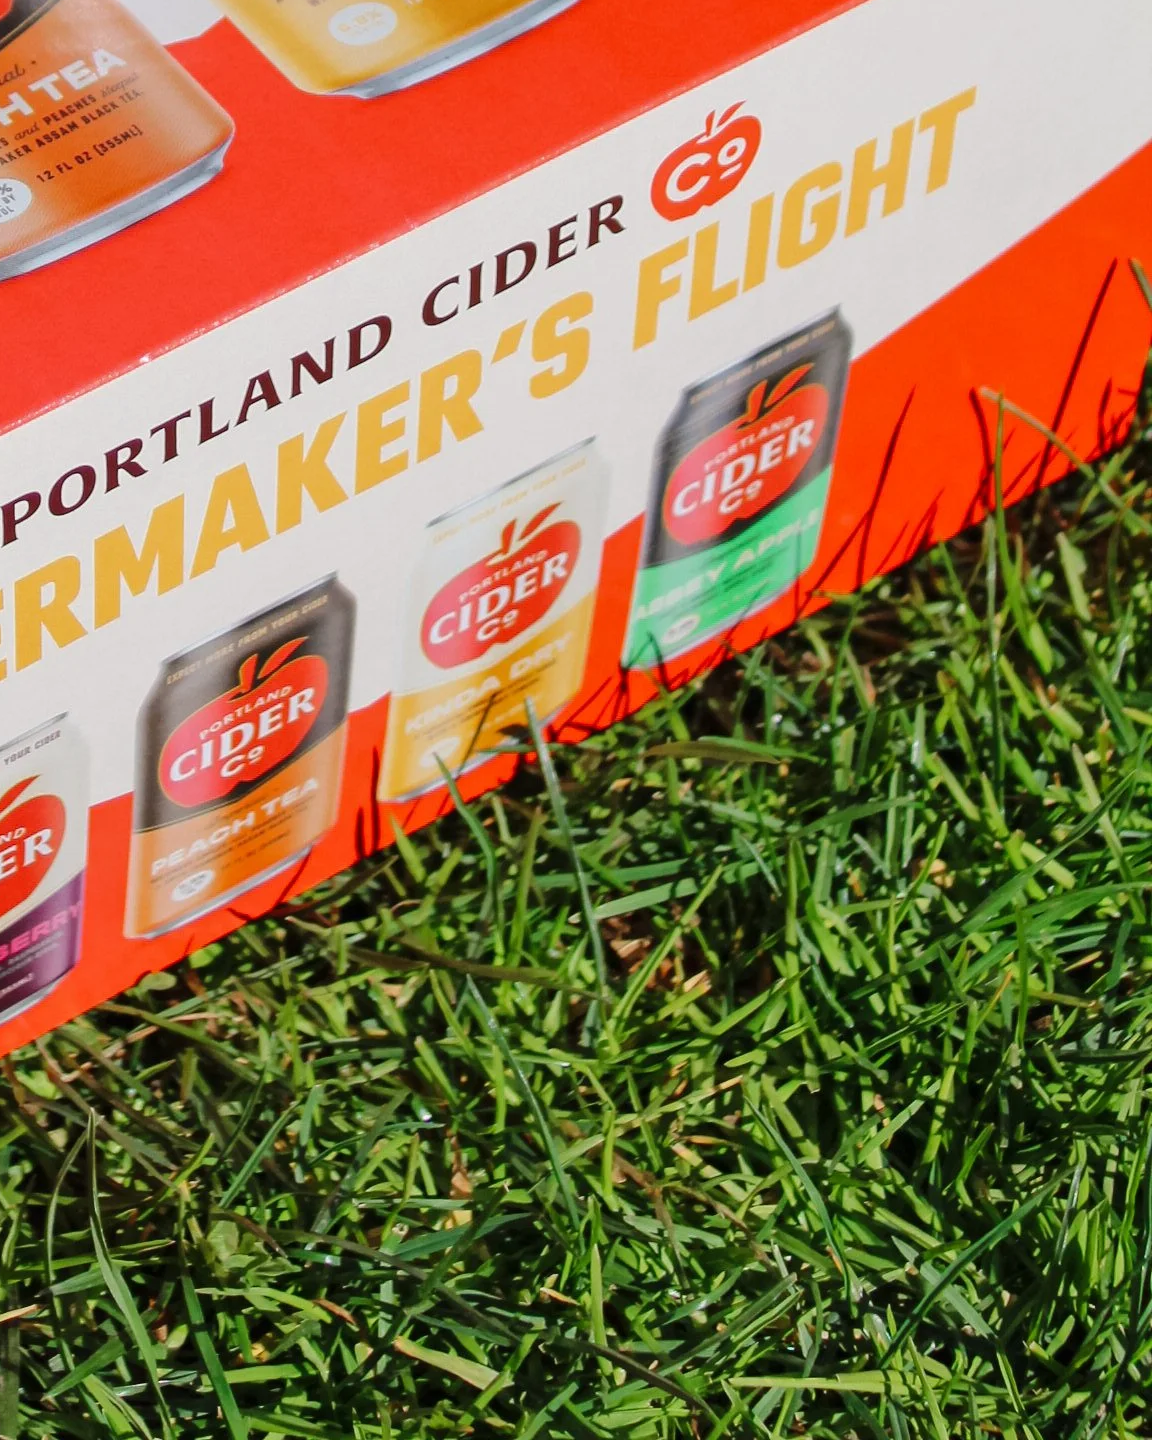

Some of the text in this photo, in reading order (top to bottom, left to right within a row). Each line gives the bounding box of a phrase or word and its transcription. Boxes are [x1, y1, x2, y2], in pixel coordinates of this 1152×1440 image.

[28, 50, 127, 101] TEA
[14, 122, 41, 141] and
[42, 94, 97, 125] PEACHES
[35, 121, 80, 148] ASSAM
[80, 101, 119, 125] BLACK
[36, 170, 55, 183] 12
[55, 162, 73, 174] FL
[74, 151, 93, 165] OZ
[632, 88, 978, 351] FLIGHT
[0, 315, 393, 547] PORTLAND
[422, 194, 625, 326] CIDER
[672, 419, 815, 517] CIDER
[704, 416, 796, 472] PORTLAND
[732, 507, 820, 571] APPLE
[429, 551, 569, 645] CIDER
[459, 550, 548, 604] PORTLAND
[199, 685, 294, 741] PORTLAND
[405, 675, 501, 736] KINDA
[509, 632, 573, 680] DRY
[4, 746, 31, 766] YOUR
[34, 730, 62, 749] CIDER
[169, 687, 315, 783] CIDER
[151, 811, 255, 876] PEACH
[260, 777, 320, 816] TEA
